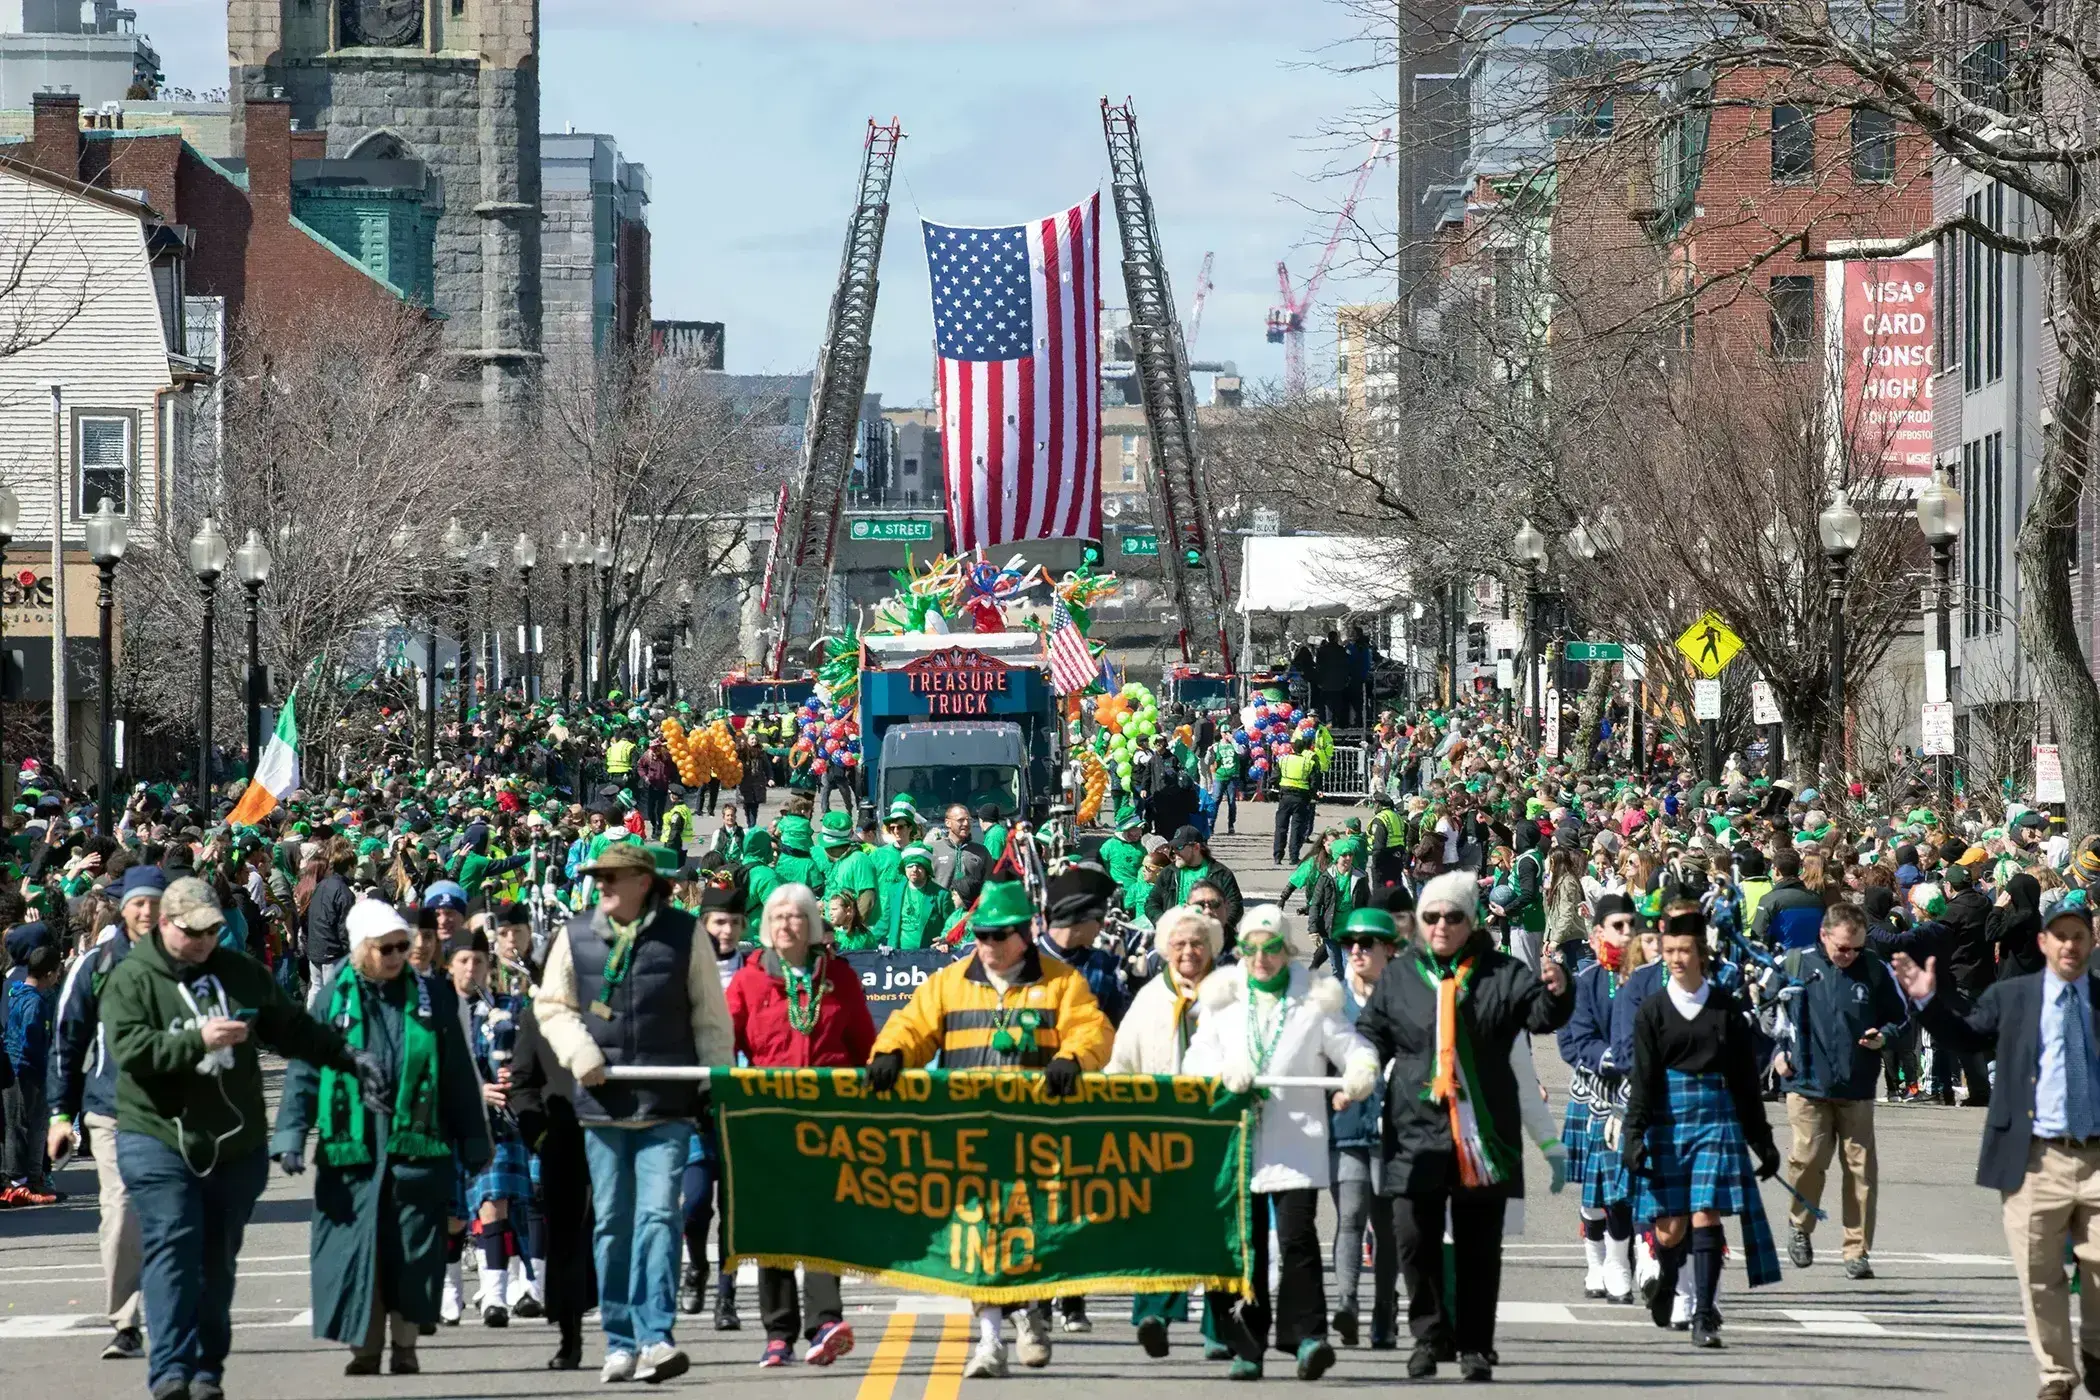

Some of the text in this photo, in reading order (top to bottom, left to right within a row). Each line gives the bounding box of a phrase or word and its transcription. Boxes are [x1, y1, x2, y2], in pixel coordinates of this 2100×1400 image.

[1863, 313, 1926, 335] CARD
[1863, 378, 1918, 400] HIGH
[1889, 410, 1934, 424] INTROD
[873, 523, 927, 535] A STREET
[1141, 541, 1149, 549] A
[1589, 645, 1597, 657] B
[908, 671, 1006, 692] TREASURE
[926, 693, 987, 714] TRUCK
[862, 965, 929, 990] a job
[730, 1067, 820, 1100] THIS
[948, 1068, 1158, 1105] SPONORED
[1172, 1074, 1222, 1107] BY
[795, 1121, 1194, 1177] CASTLE ISLAND
[835, 1163, 1152, 1225] ASSOCIATION
[949, 1222, 1043, 1276] INC.
